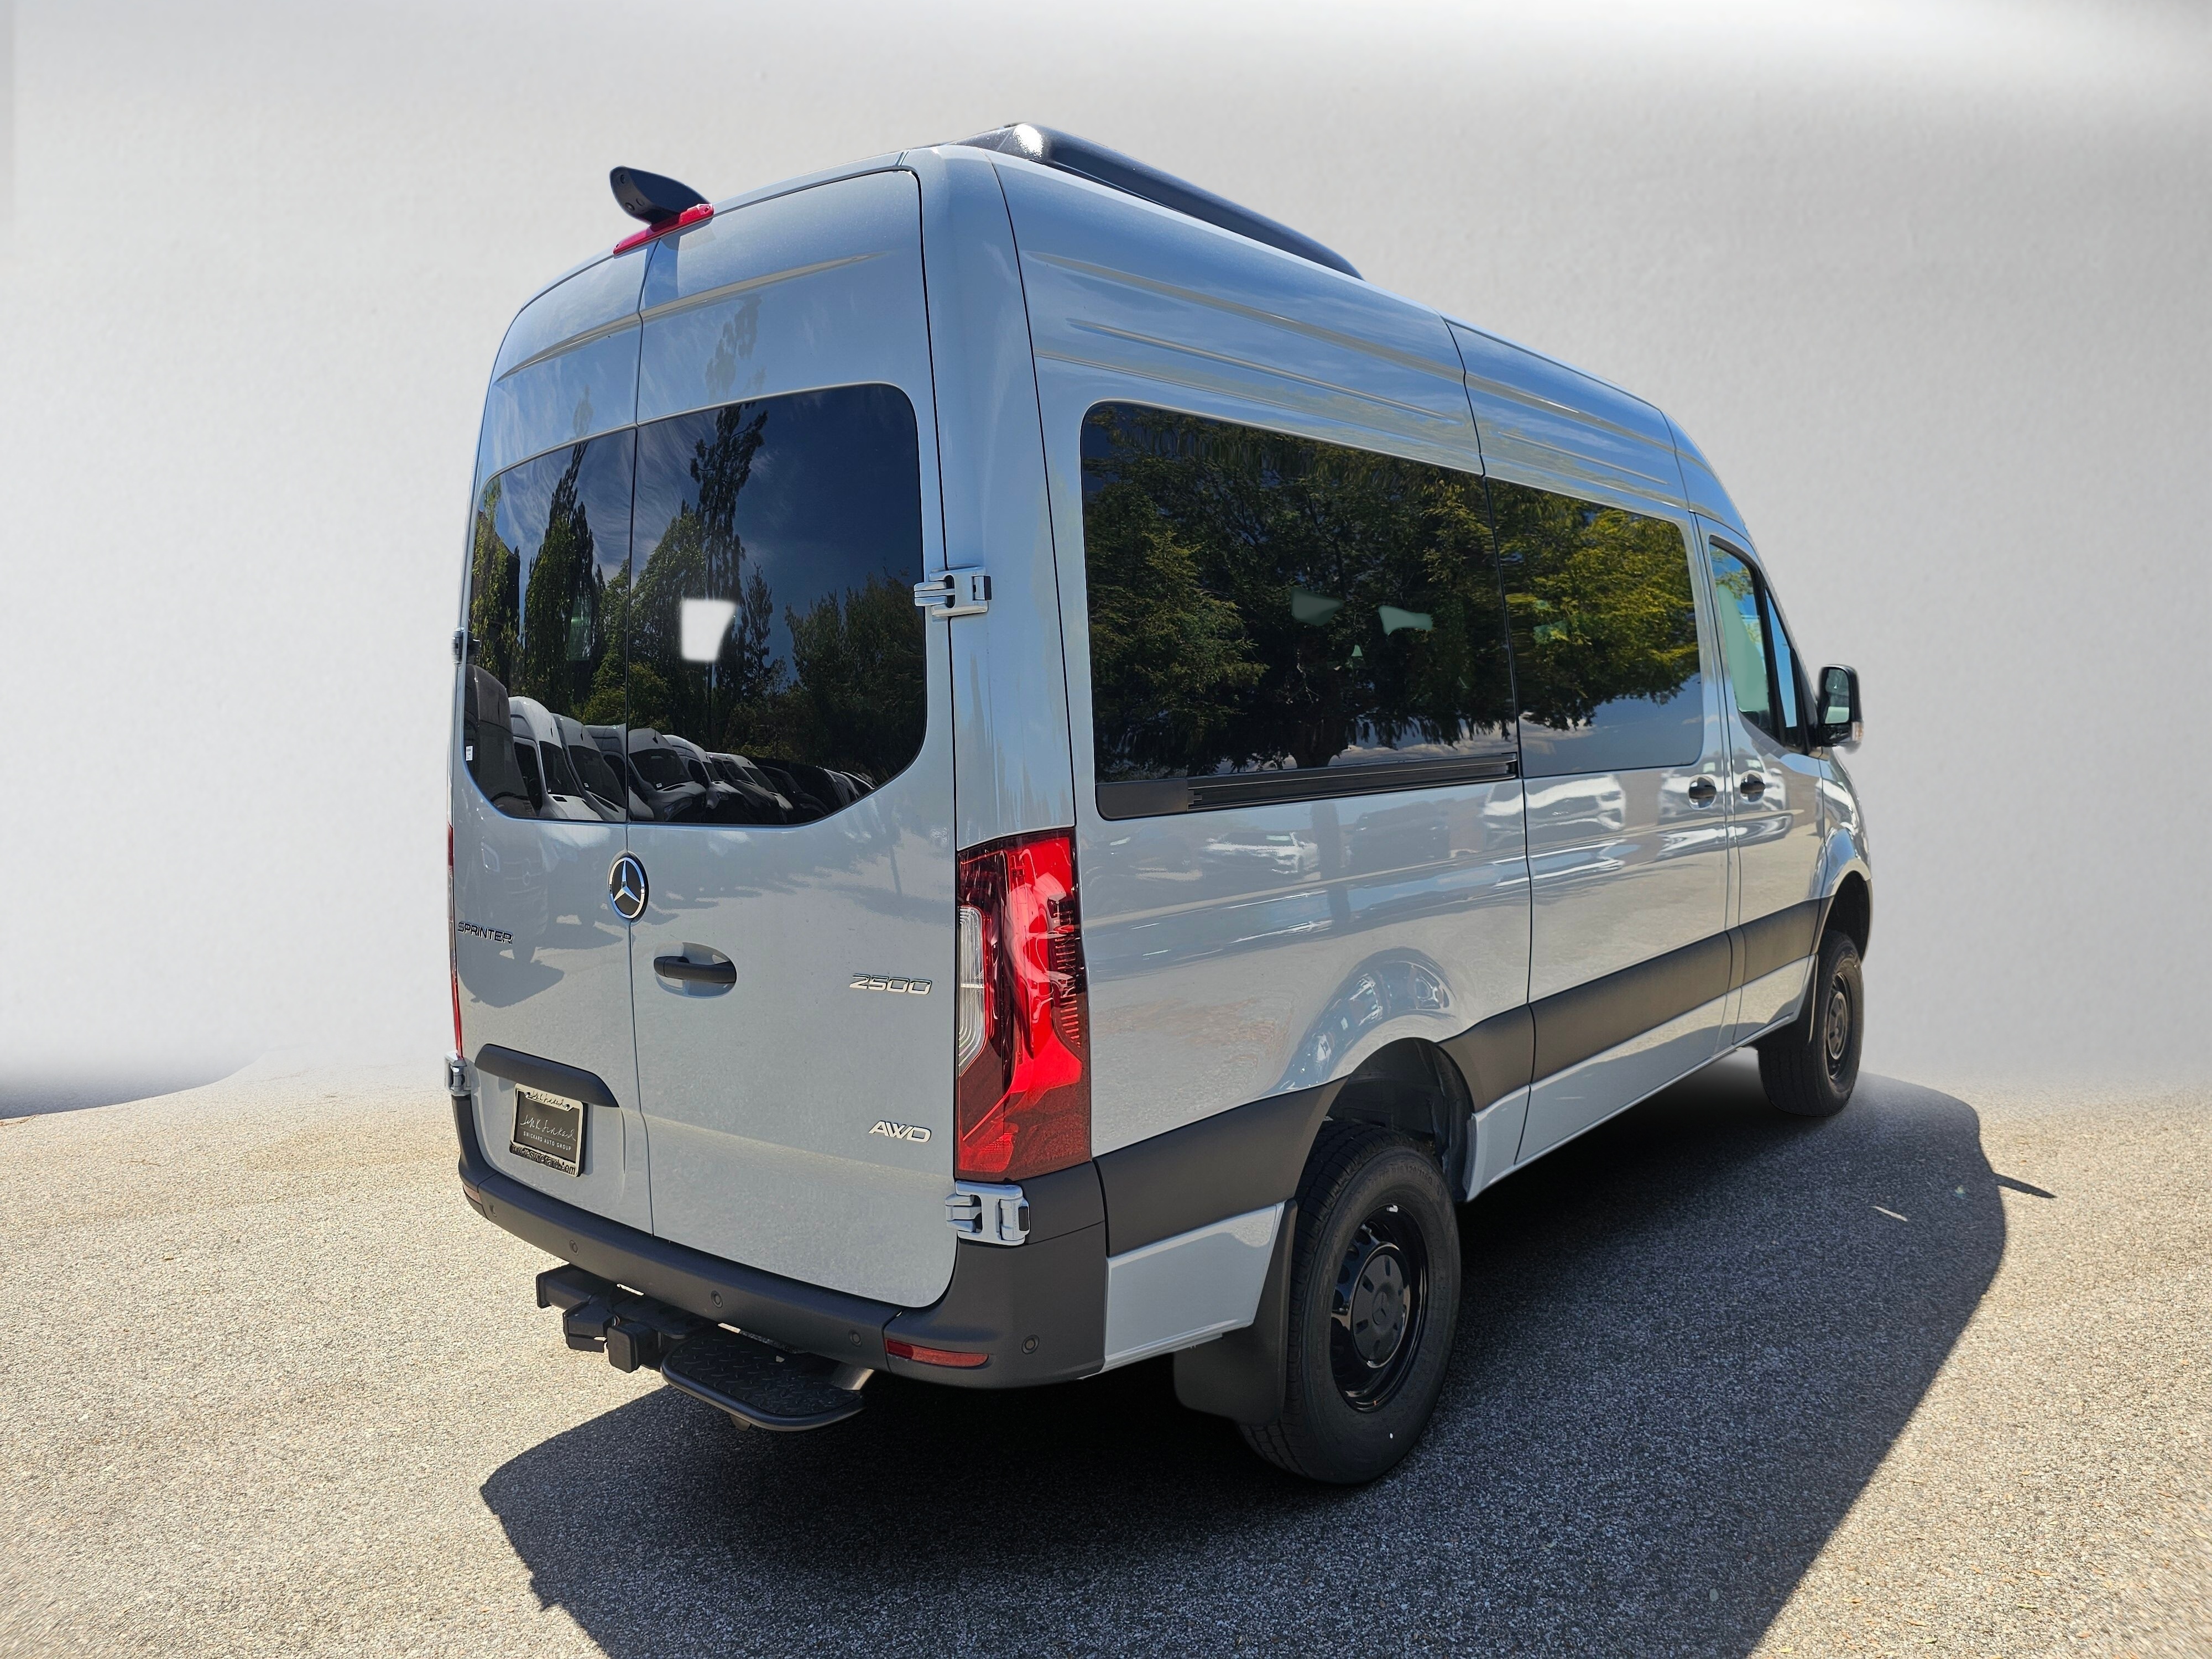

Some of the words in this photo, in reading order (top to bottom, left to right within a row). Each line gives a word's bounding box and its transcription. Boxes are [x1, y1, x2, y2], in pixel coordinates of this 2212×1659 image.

[457, 921, 514, 945] SPRINTER
[849, 973, 932, 995] 2500
[523, 1131, 542, 1142] SWICKARD
[544, 1138, 555, 1146] AUTO
[557, 1142, 572, 1151] GROUP
[869, 1120, 932, 1142] AWD
